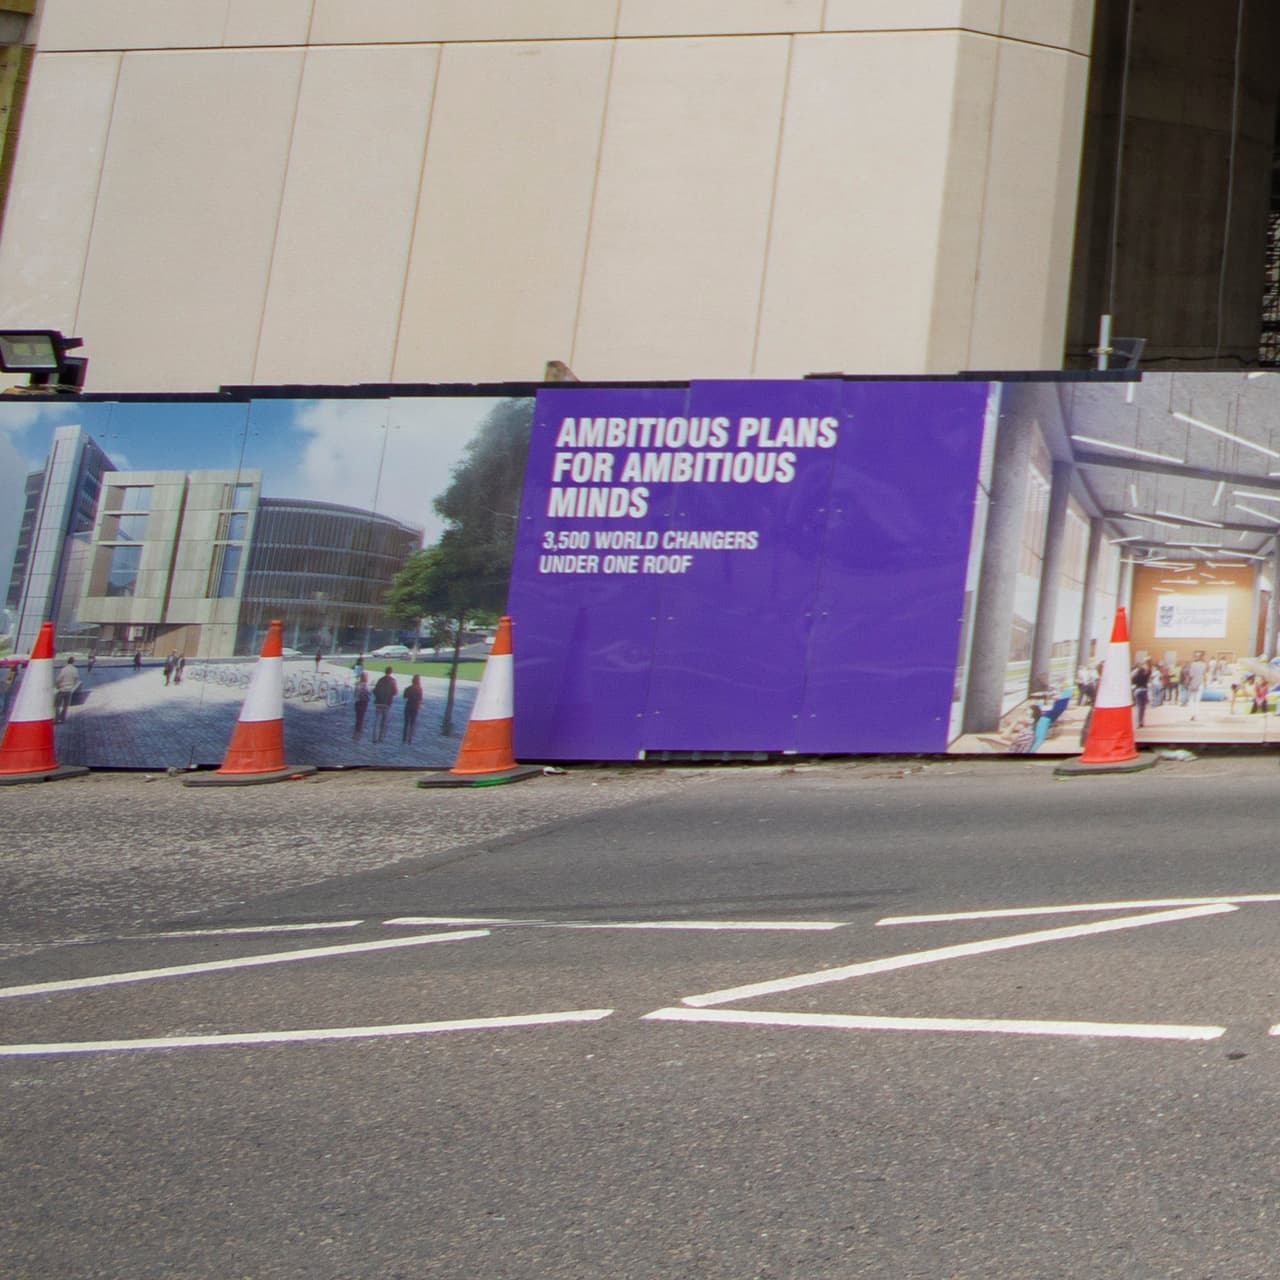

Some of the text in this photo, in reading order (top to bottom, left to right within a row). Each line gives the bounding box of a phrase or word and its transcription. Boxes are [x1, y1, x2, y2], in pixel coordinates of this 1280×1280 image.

[555, 417, 839, 448] AMBITIOUS PLANS
[551, 452, 797, 483] FOR AMBITIOUS
[547, 487, 650, 518] MINDS
[543, 531, 759, 552] 3,500 WORLD CHANGERS
[539, 555, 693, 574] UNDER ONE ROOF
